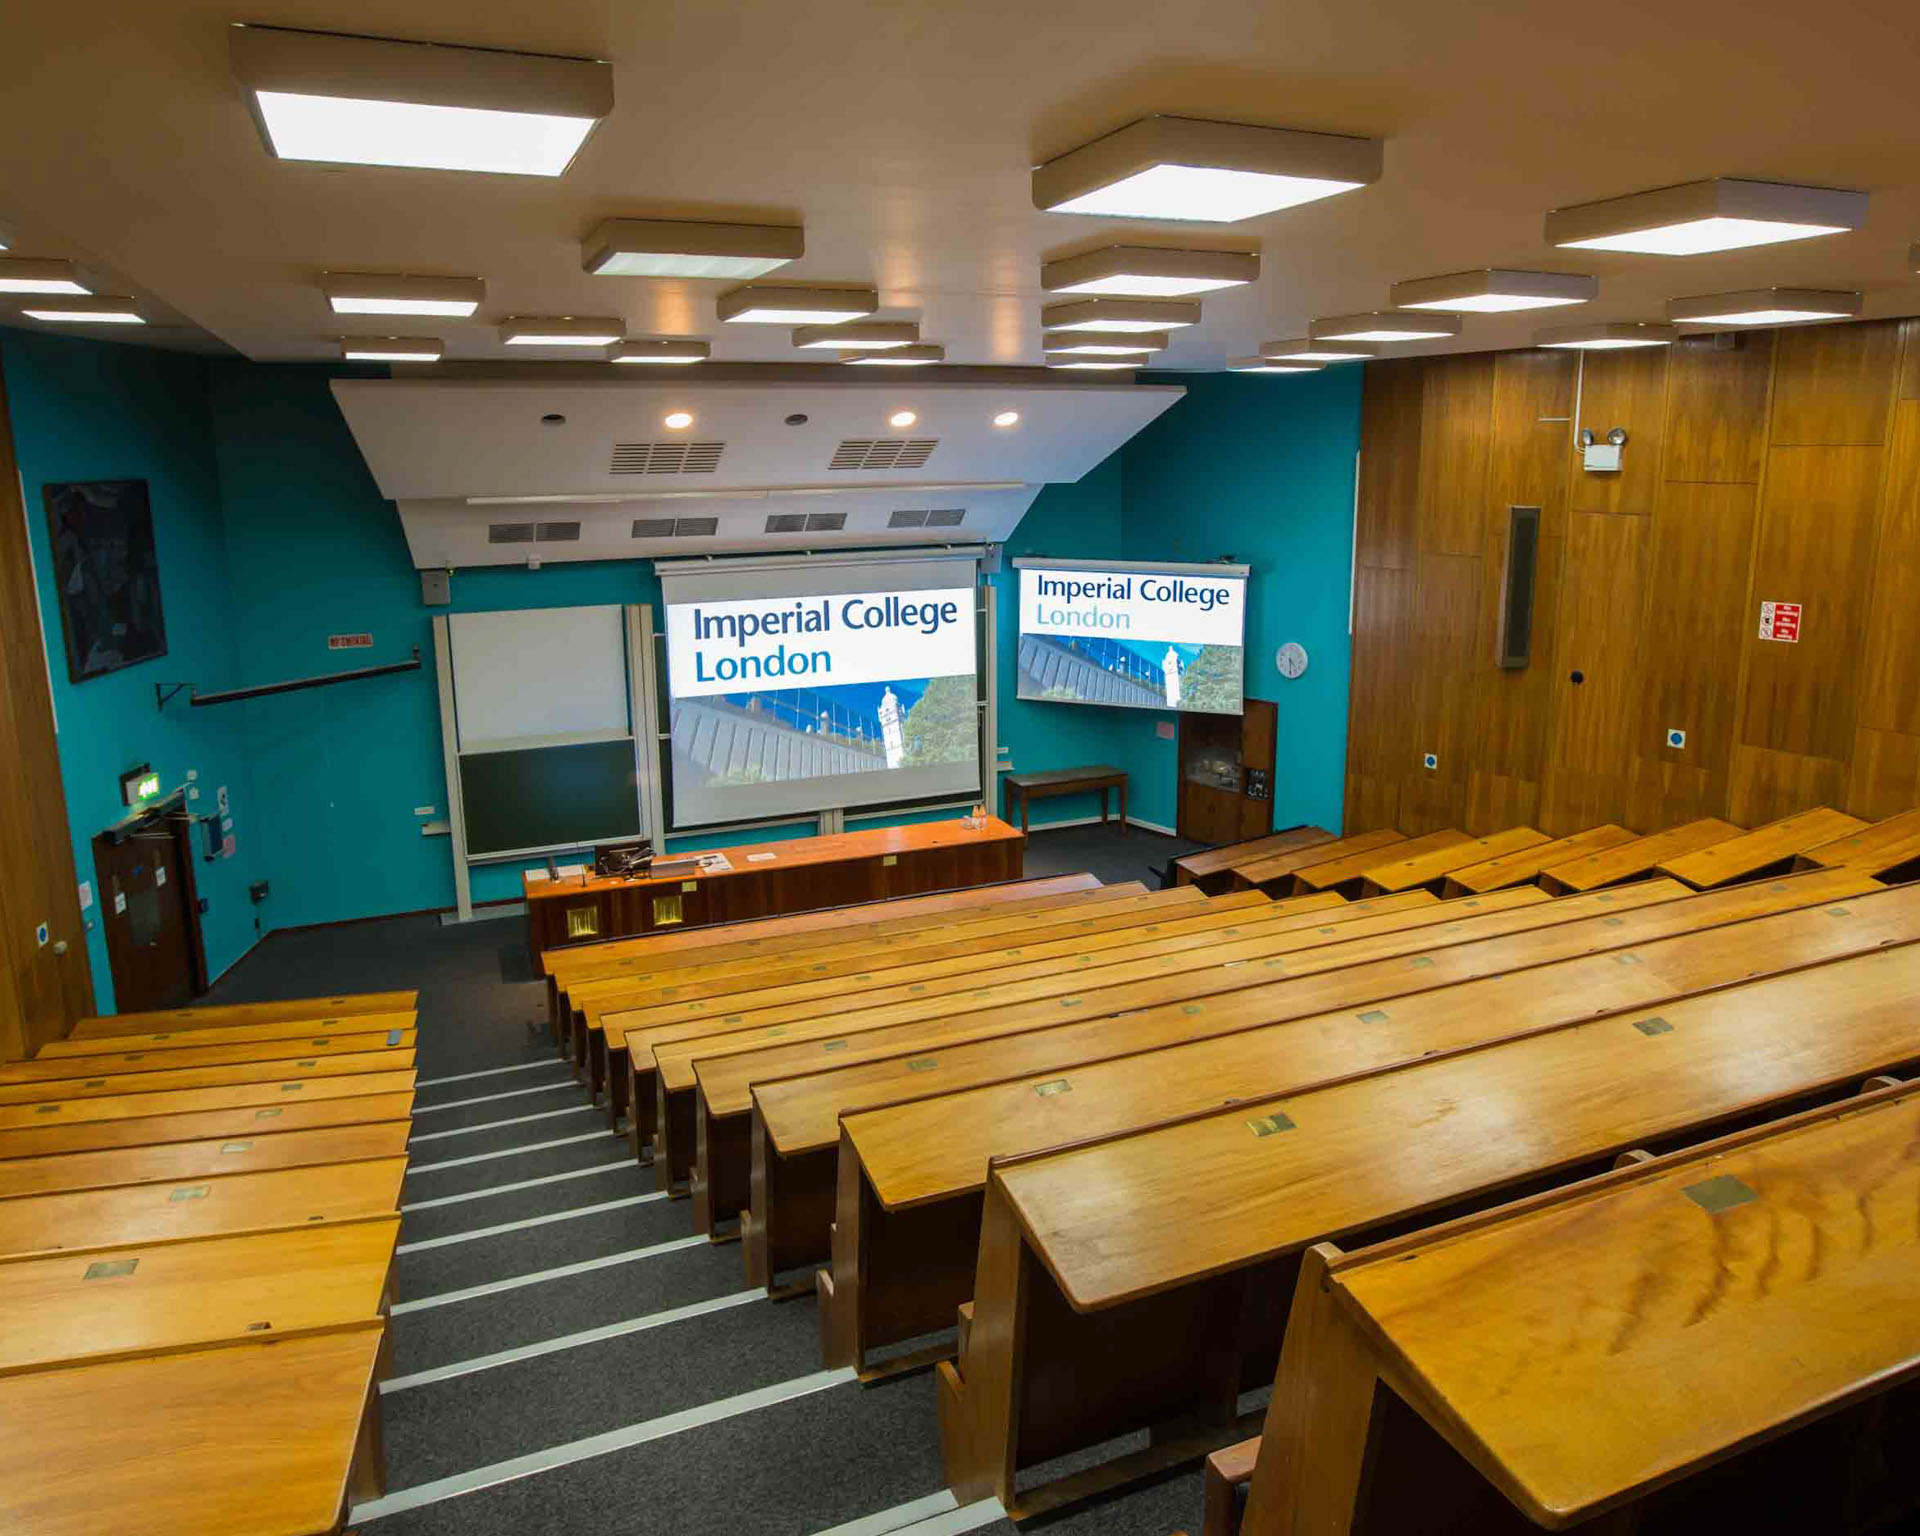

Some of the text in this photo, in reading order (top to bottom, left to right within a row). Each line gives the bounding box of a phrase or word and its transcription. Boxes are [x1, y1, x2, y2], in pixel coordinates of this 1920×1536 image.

[1038, 575, 1230, 611] Imperial College
[694, 596, 957, 647] Imperial College
[1037, 603, 1130, 629] London
[695, 644, 831, 682] London
